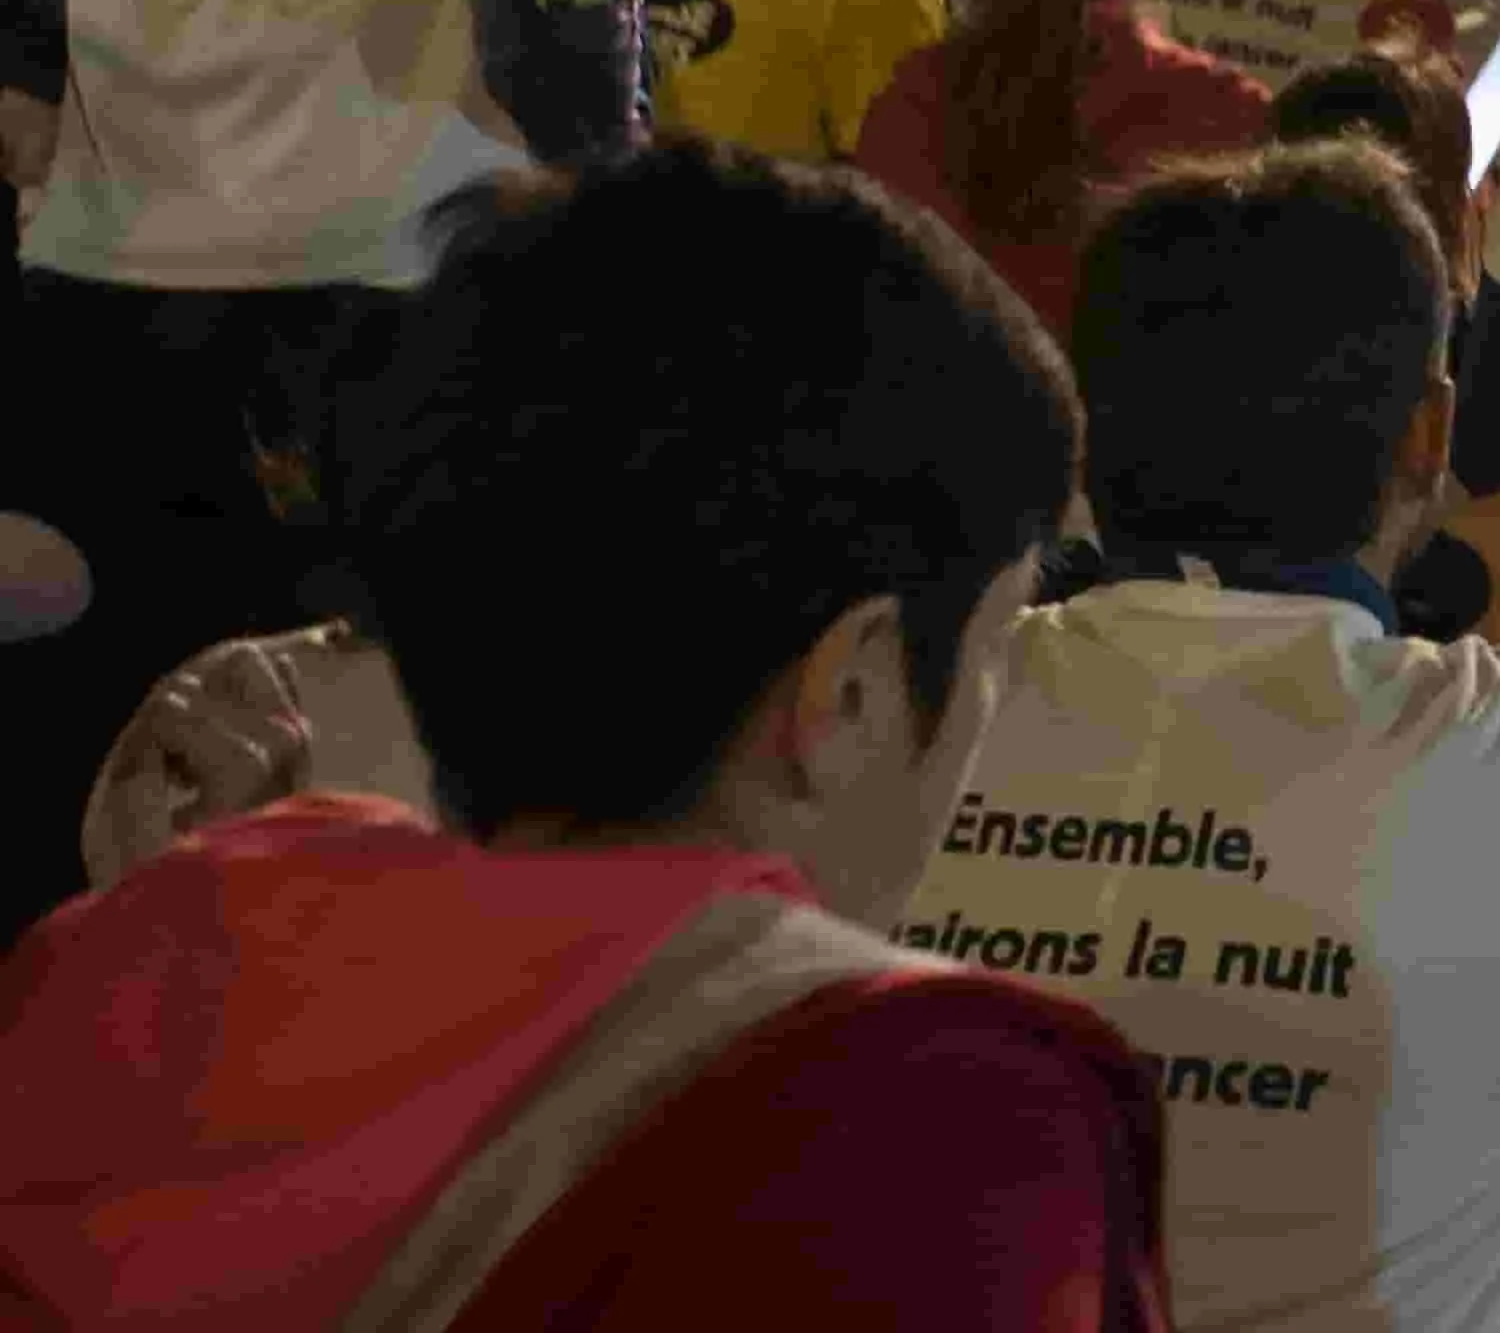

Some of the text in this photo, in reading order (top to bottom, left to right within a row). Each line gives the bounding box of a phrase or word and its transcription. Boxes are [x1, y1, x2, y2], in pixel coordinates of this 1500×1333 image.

[942, 791, 1269, 883] Ensemble,
[1124, 919, 1187, 981] la
[1213, 937, 1356, 999] nuit
[1160, 1053, 1331, 1113] ncer
